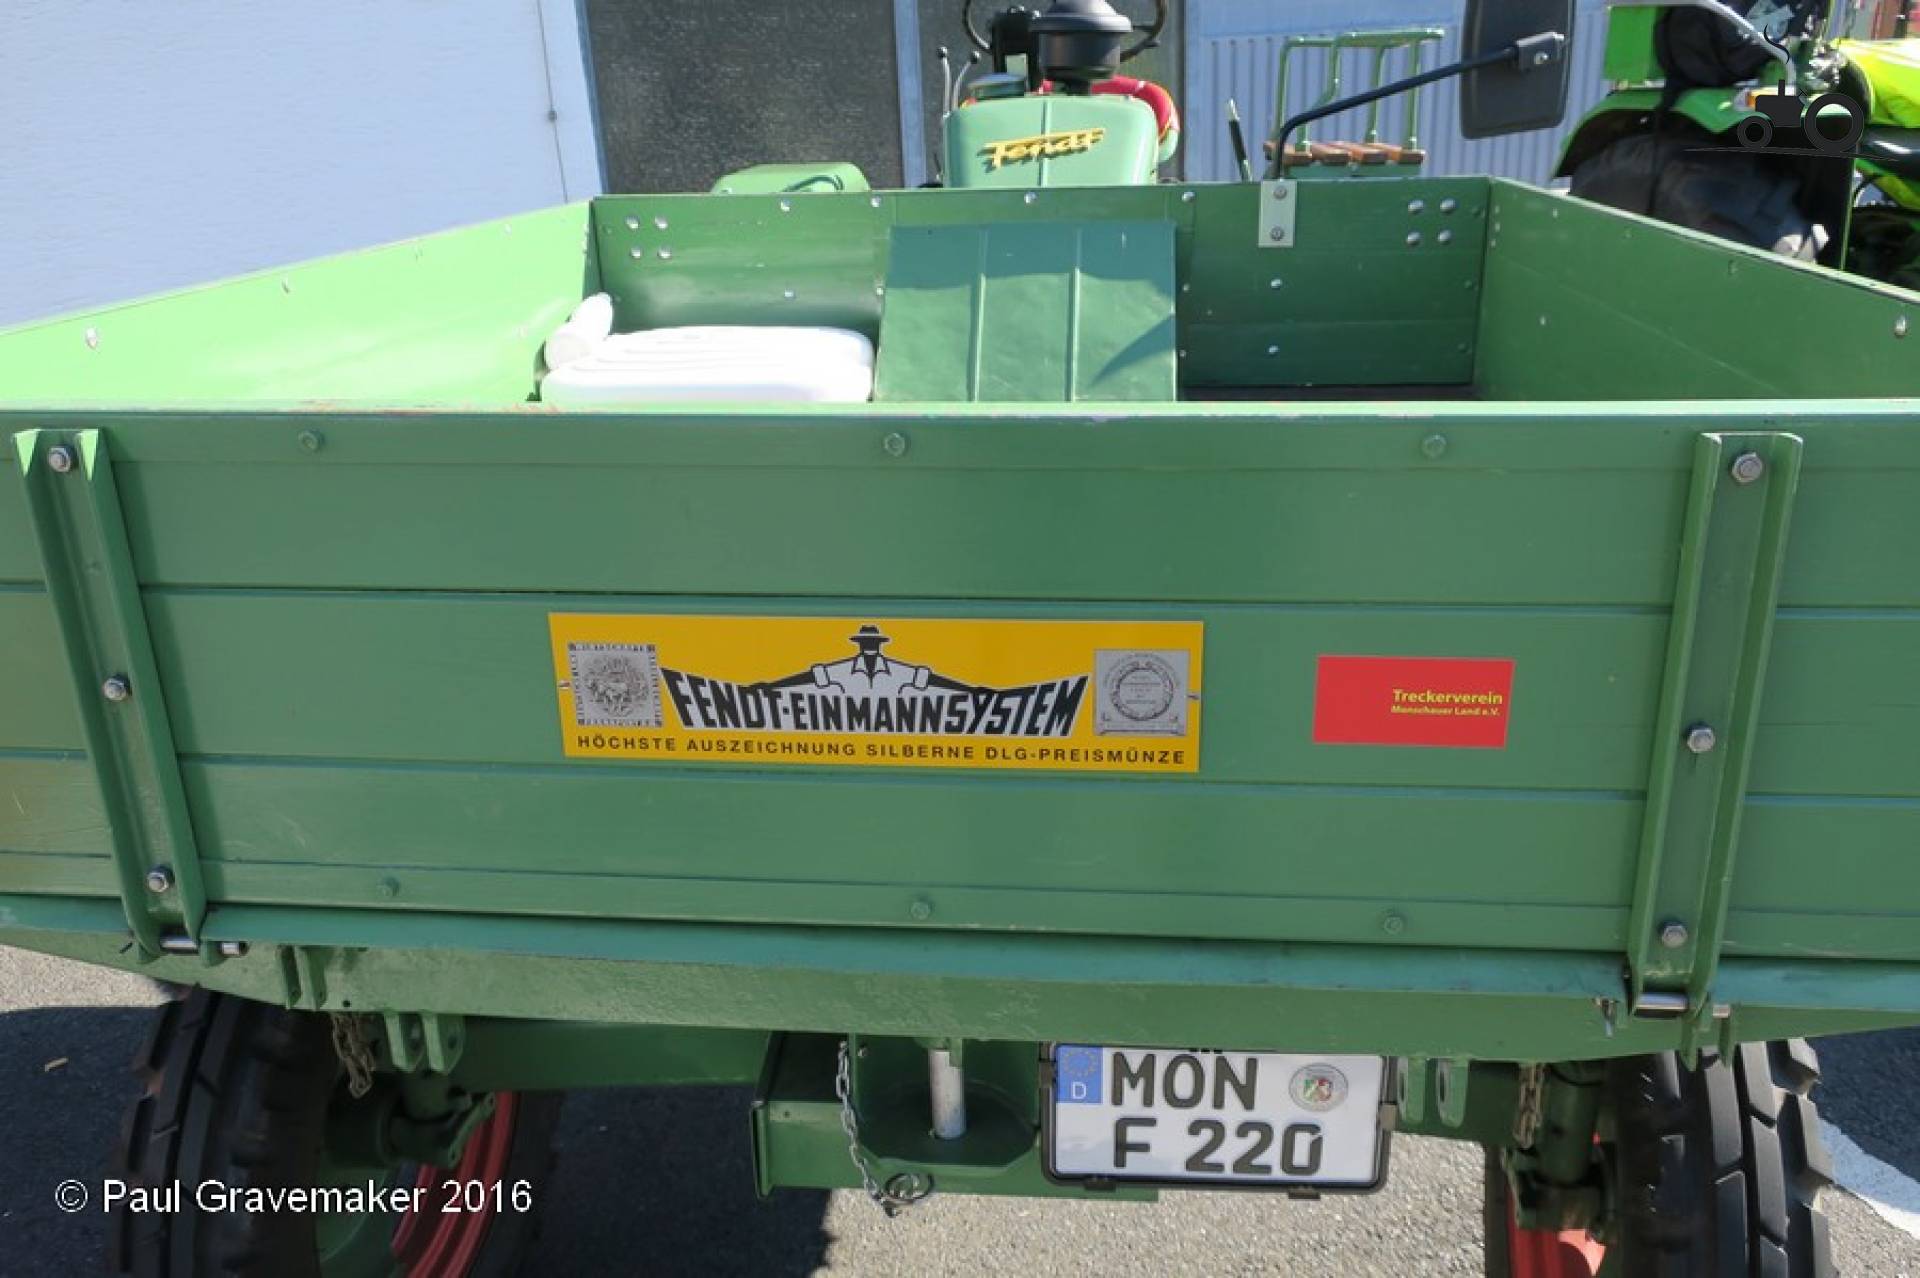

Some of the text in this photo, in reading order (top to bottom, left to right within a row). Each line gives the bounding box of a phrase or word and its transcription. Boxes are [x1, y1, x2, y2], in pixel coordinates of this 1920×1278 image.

[1392, 688, 1503, 705] Treckerverein
[1454, 707, 1481, 716] Land
[577, 734, 1185, 764] HÖCHSTE AUSZEICHNUNG SILBERNE DLG-PREISMÜNZE
[1071, 1081, 1087, 1099] D
[1113, 1117, 1324, 1176] F 220
